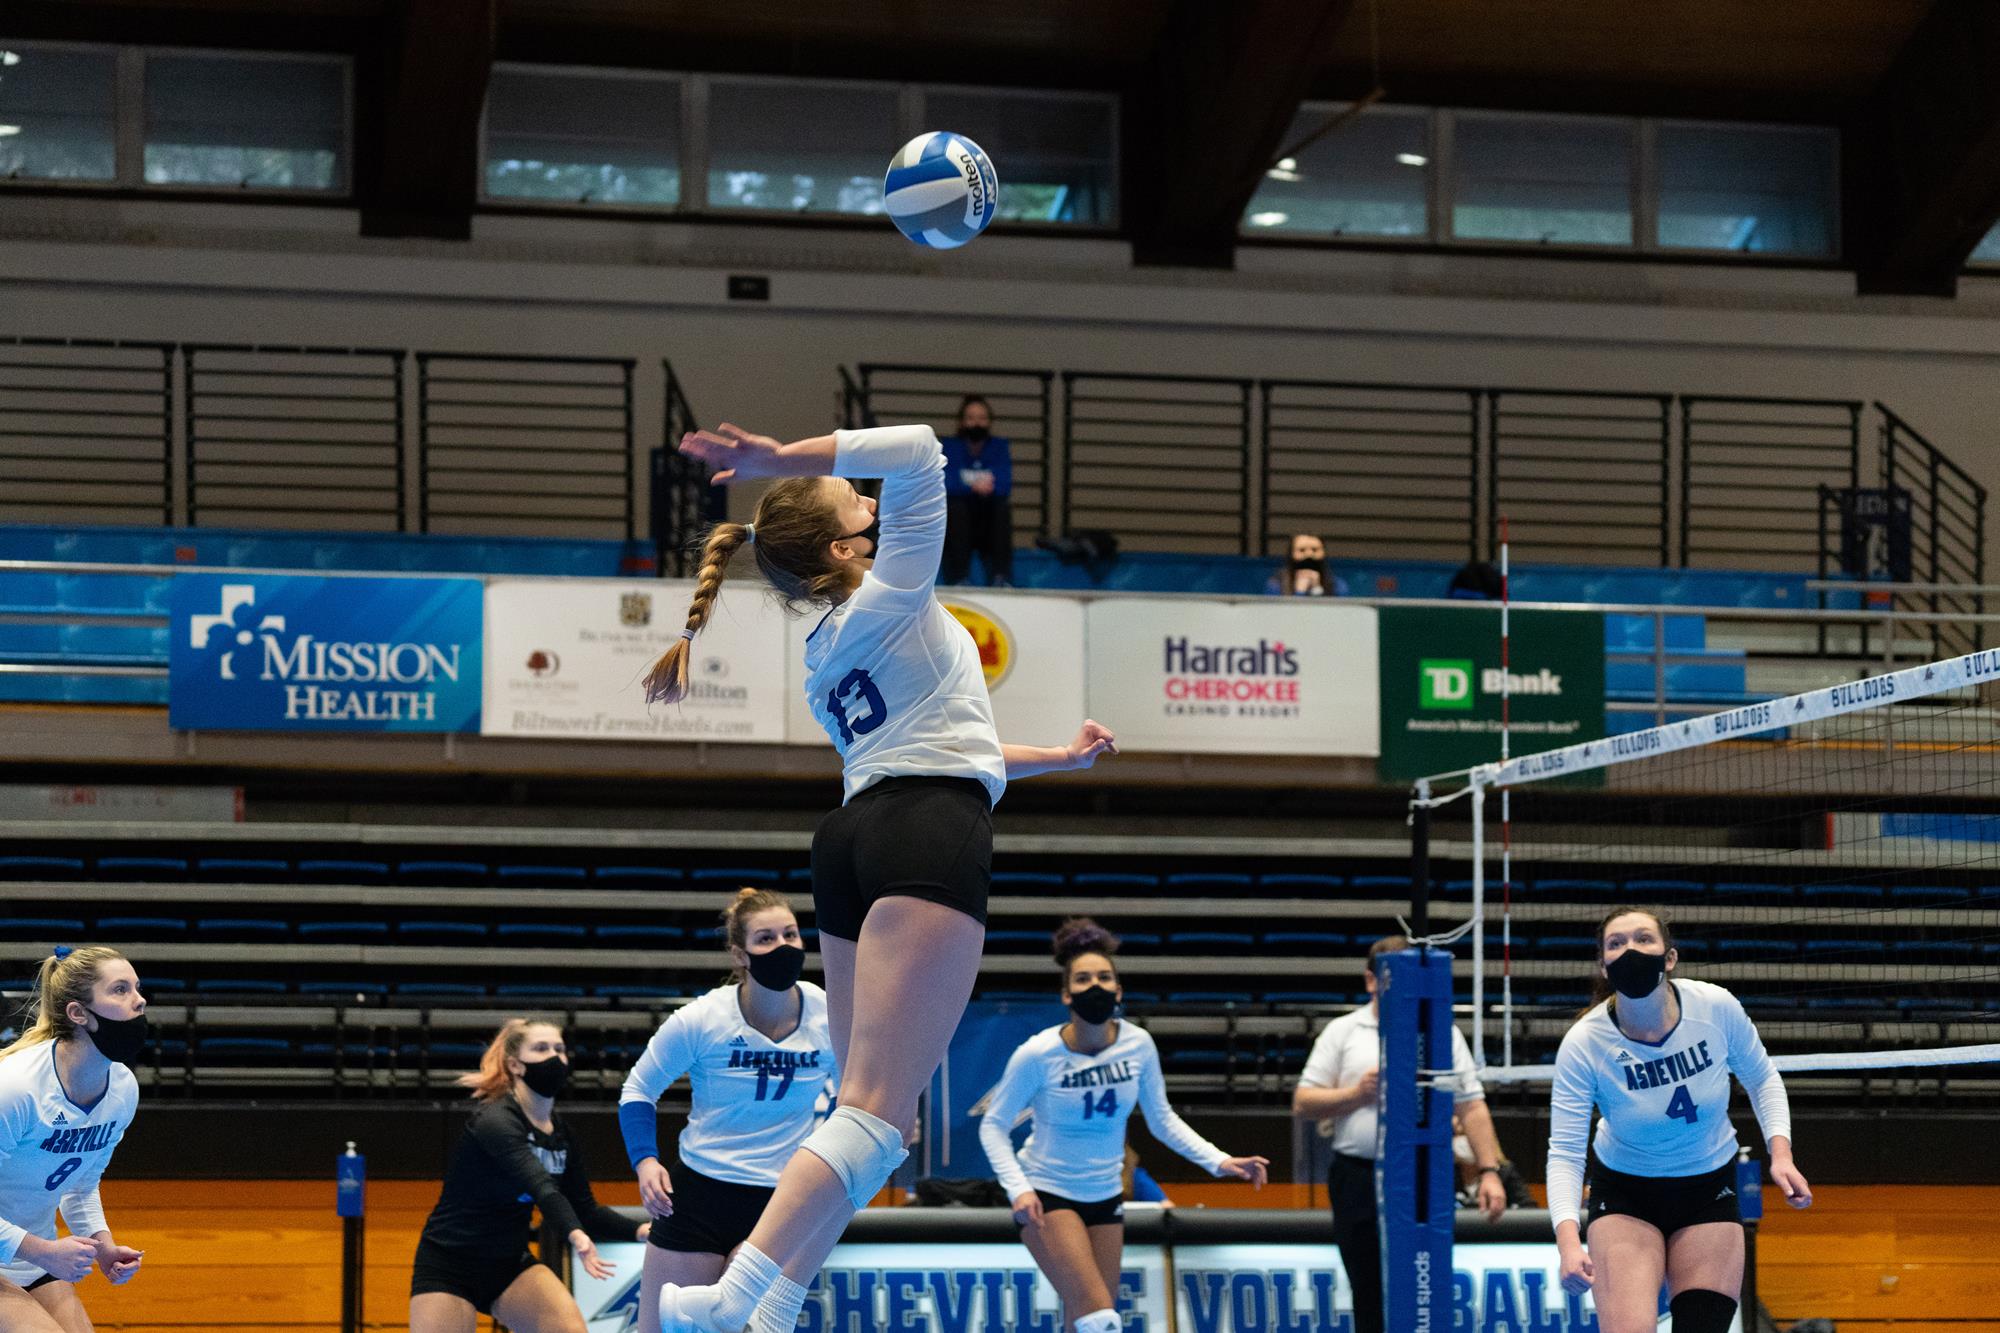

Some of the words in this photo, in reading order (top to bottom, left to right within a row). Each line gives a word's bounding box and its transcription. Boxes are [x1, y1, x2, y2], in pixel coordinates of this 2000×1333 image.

[960, 154, 983, 217] molten
[1165, 678, 1299, 702] CHEROKEE
[1424, 667, 1468, 700] TD
[1482, 668, 1561, 695] Bank
[827, 668, 887, 746] 13
[1165, 703, 1230, 717] CASINO
[1238, 704, 1299, 717] RESORT
[728, 1049, 820, 1068] ASHEVILLE
[1061, 1061, 1132, 1088] ASHEVILLE
[1623, 1040, 1713, 1091] ASHEVILLE
[755, 1064, 797, 1101] 17
[1083, 1088, 1120, 1120] 14
[1665, 1084, 1699, 1124] 4
[40, 1120, 117, 1153] ASHEVILLE
[44, 1157, 82, 1191] 8
[1414, 1251, 1432, 1306] sports
[1178, 1268, 1600, 1333] VOLLBALL
